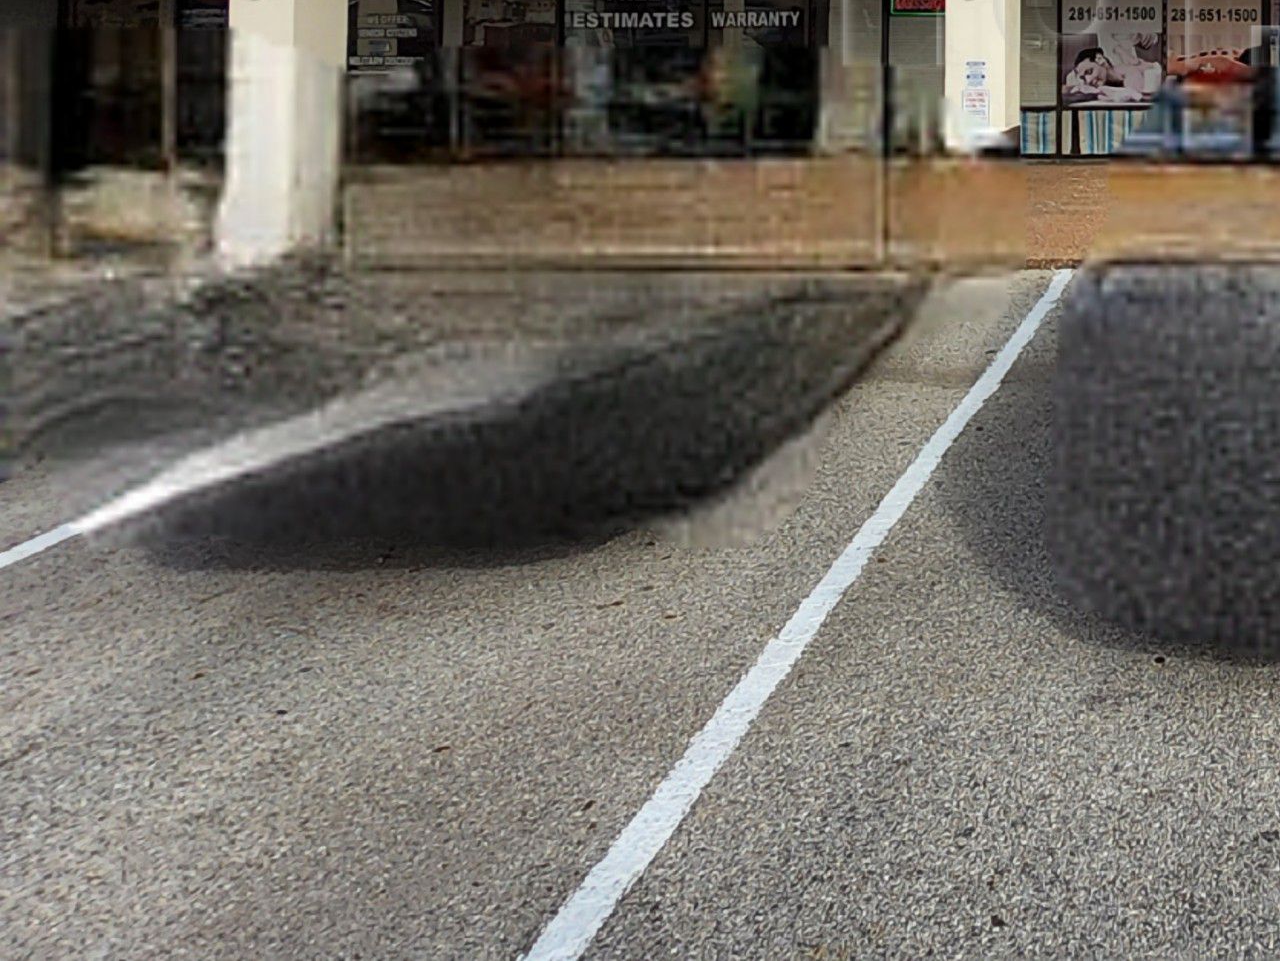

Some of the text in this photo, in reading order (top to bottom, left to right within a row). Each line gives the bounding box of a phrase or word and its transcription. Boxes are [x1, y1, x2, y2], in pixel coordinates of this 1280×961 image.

[573, 11, 695, 29] ESTIMATES
[711, 10, 801, 28] WARRANTY
[1170, 8, 1258, 23] 281-651-1500
